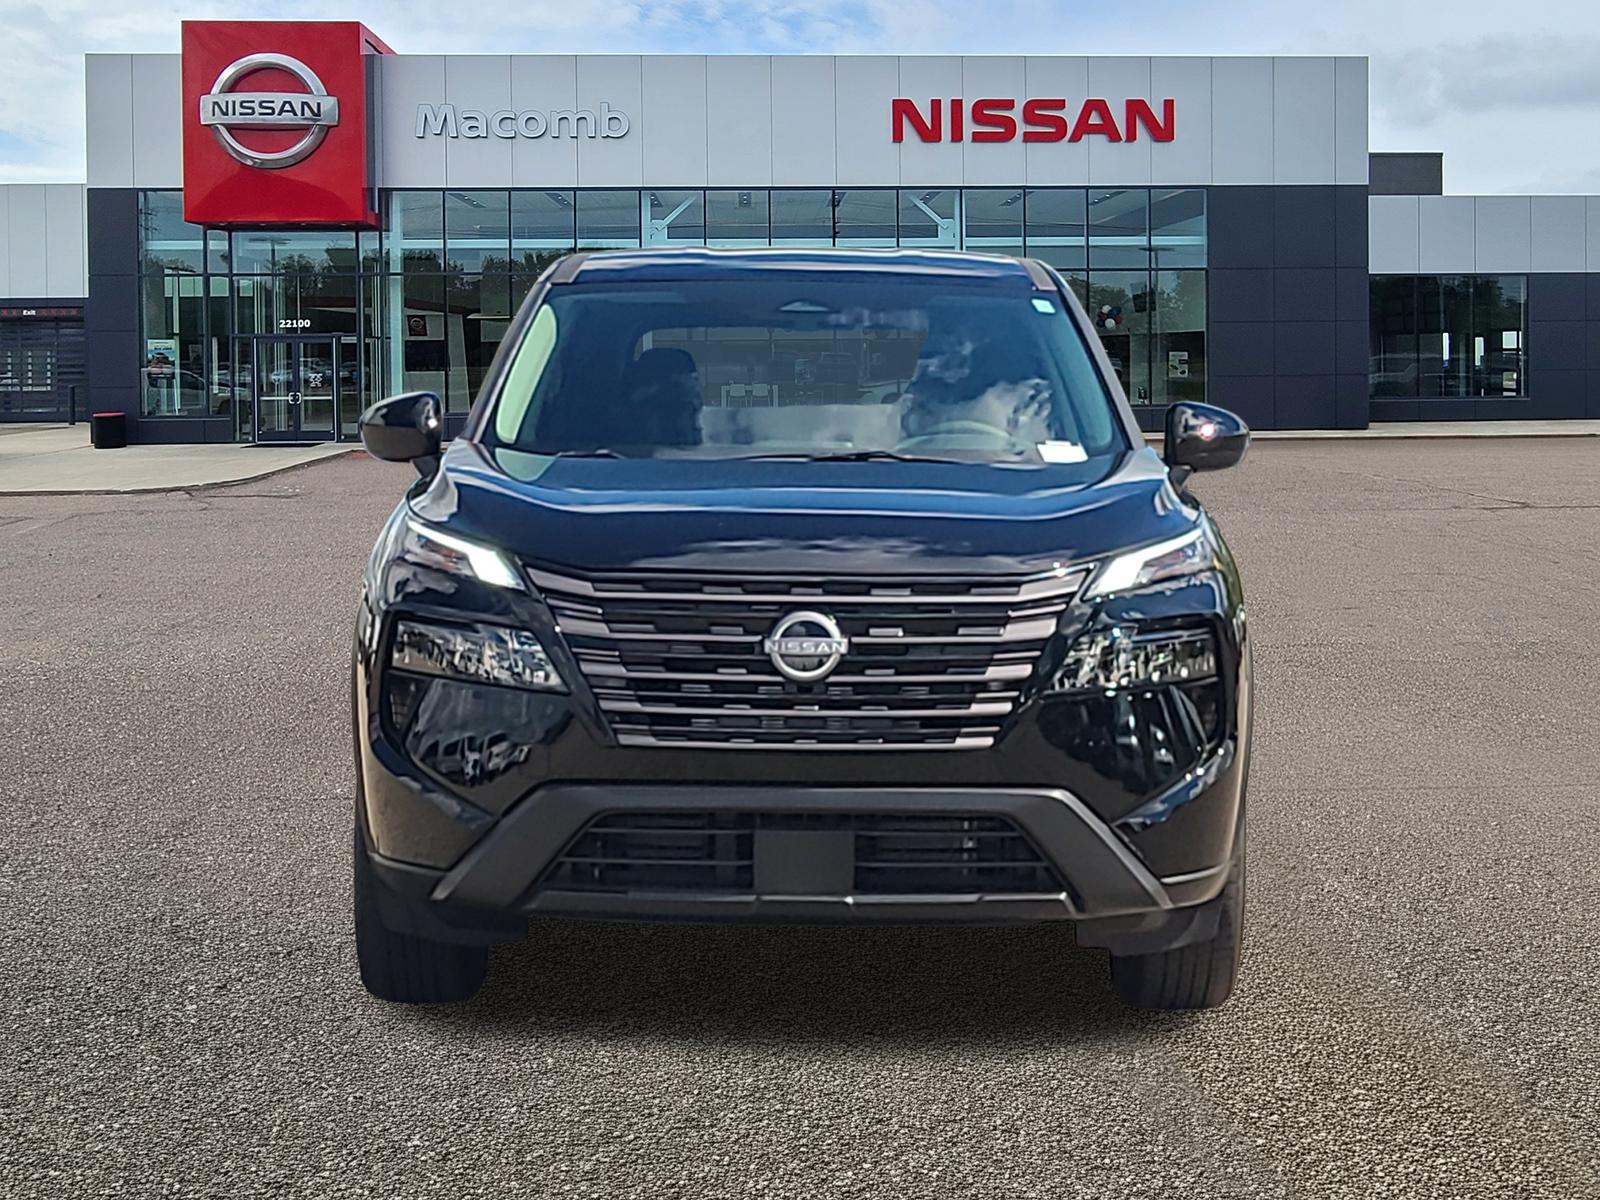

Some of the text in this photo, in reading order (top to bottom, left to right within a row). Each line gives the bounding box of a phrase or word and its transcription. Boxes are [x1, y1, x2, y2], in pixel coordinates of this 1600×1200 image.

[212, 100, 322, 118] NISSAN
[415, 102, 630, 139] Macomb
[892, 98, 1176, 143] NISSAN
[279, 319, 311, 328] 22100
[764, 639, 847, 654] NISSAN
